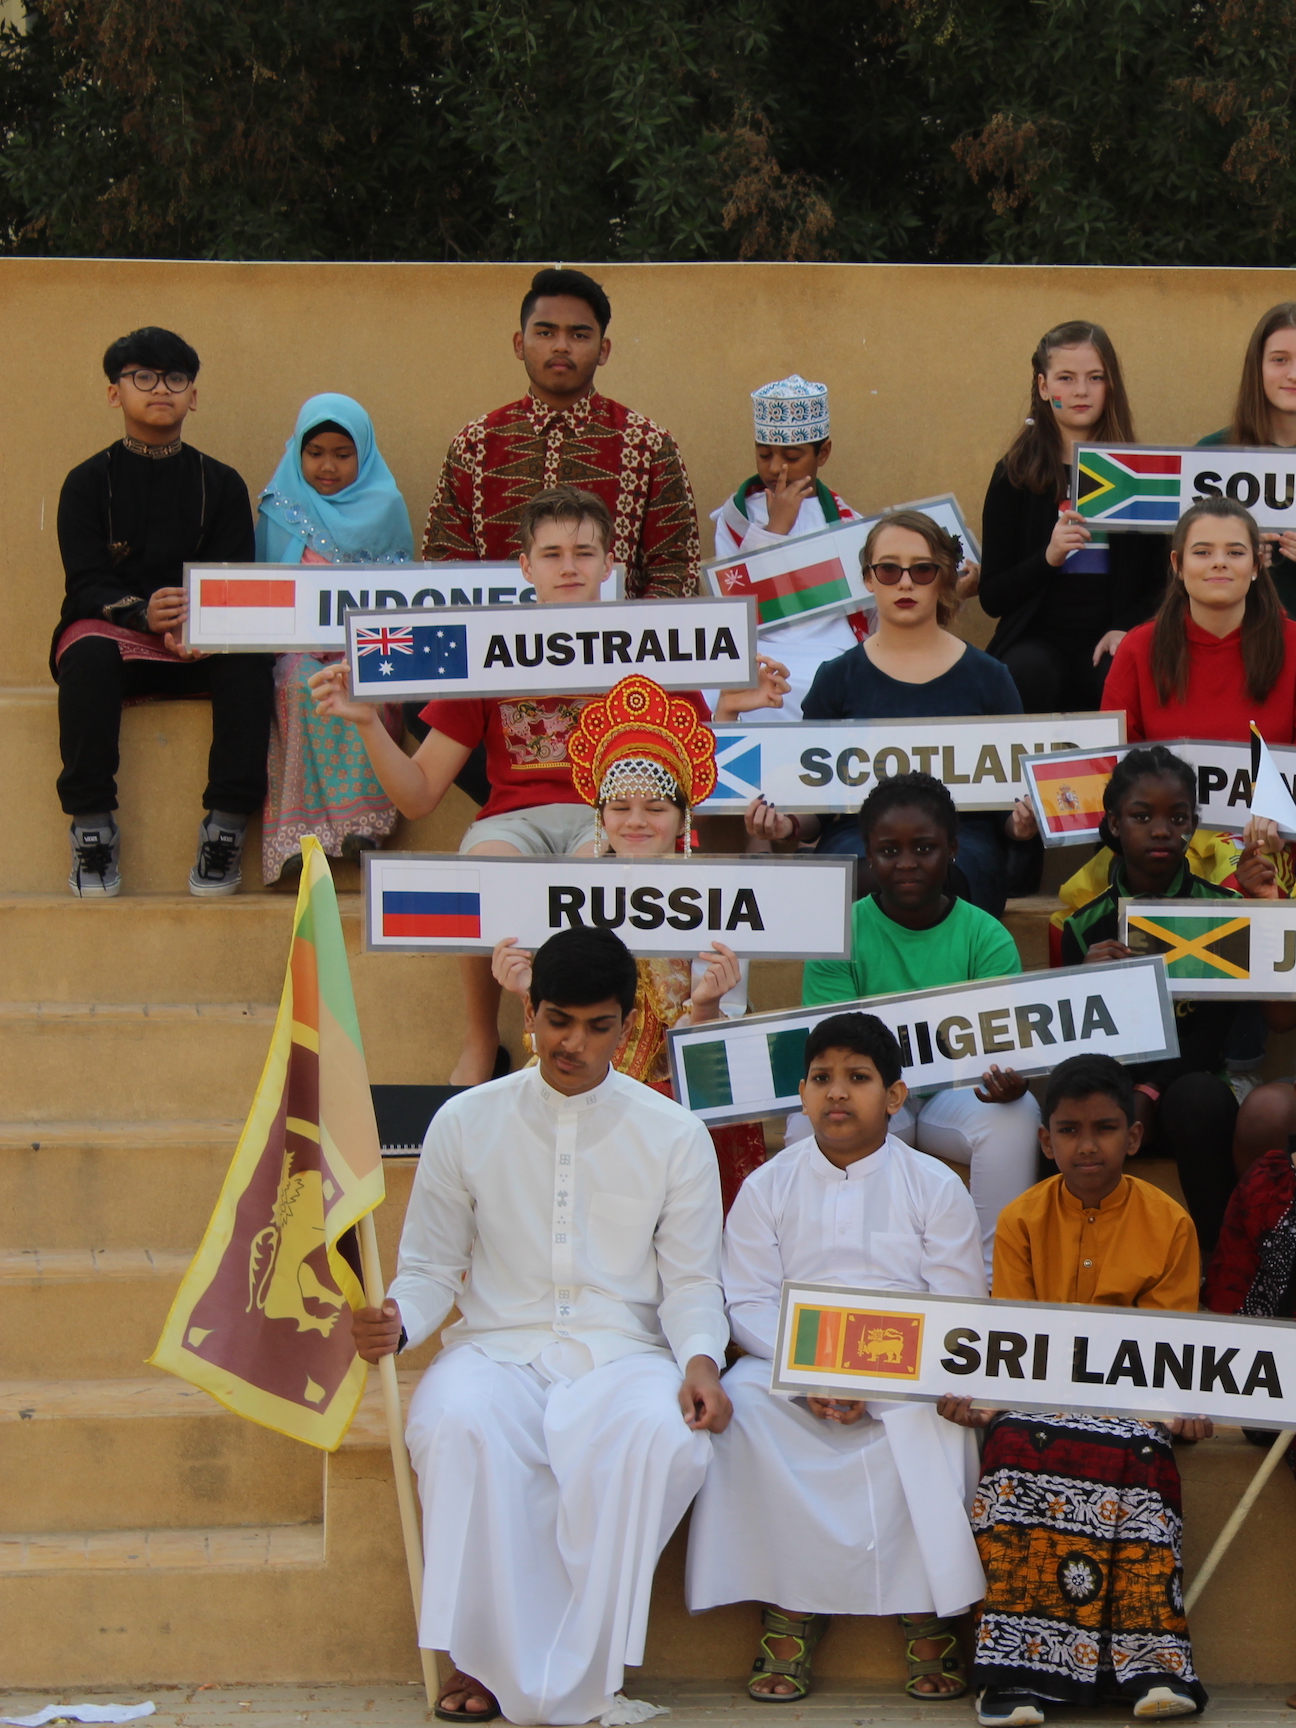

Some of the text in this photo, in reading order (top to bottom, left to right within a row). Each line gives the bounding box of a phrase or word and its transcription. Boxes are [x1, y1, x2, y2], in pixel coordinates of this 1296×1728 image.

[482, 626, 741, 669] AUSTRALIA
[799, 742, 1081, 787] SCOTLAN
[548, 886, 764, 931] RUSSIA
[940, 1327, 1283, 1398] SRI LANKA
